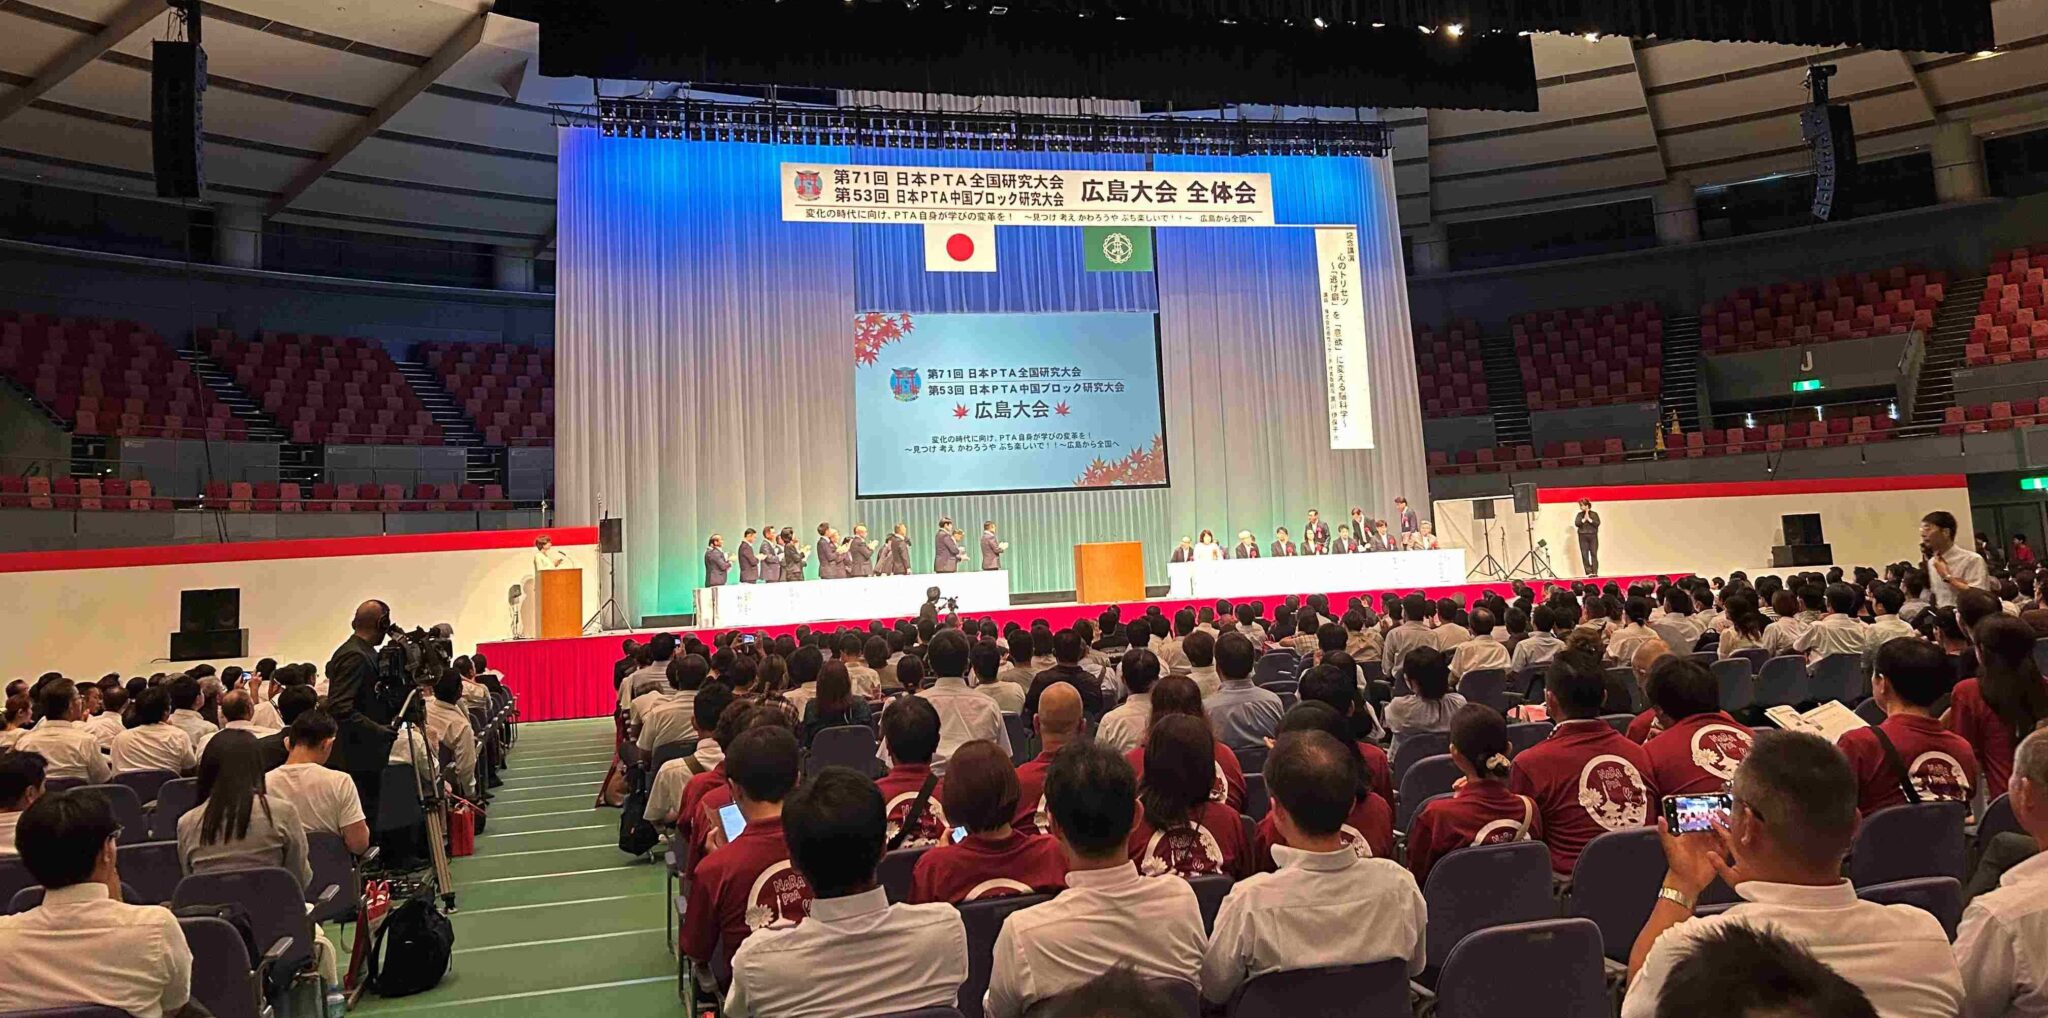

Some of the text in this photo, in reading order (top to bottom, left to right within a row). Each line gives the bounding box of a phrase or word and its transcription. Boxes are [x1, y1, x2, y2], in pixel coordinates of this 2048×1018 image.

[834, 169, 1064, 190] 第71回 日本PTA全国研究大会
[835, 187, 1064, 207] 第53回 日本PTA中国ブロック研究大会
[1081, 179, 1257, 204] 広島大会 全体会
[1060, 213, 1076, 222] 考え
[1078, 213, 1119, 222] かわろうや
[1200, 214, 1255, 223] 広島から全国へ
[1337, 253, 1348, 306] 心のトリセツ
[1800, 351, 1813, 371] J
[927, 366, 1082, 380] 第71回 日本PTA全国研究大会
[928, 382, 1125, 396] 第53回 日本PTA中国ブロック研究大会
[974, 400, 1050, 419] 広島大会
[940, 445, 955, 453] 考え
[958, 443, 996, 452] かわろうや
[773, 874, 806, 893] NARA
